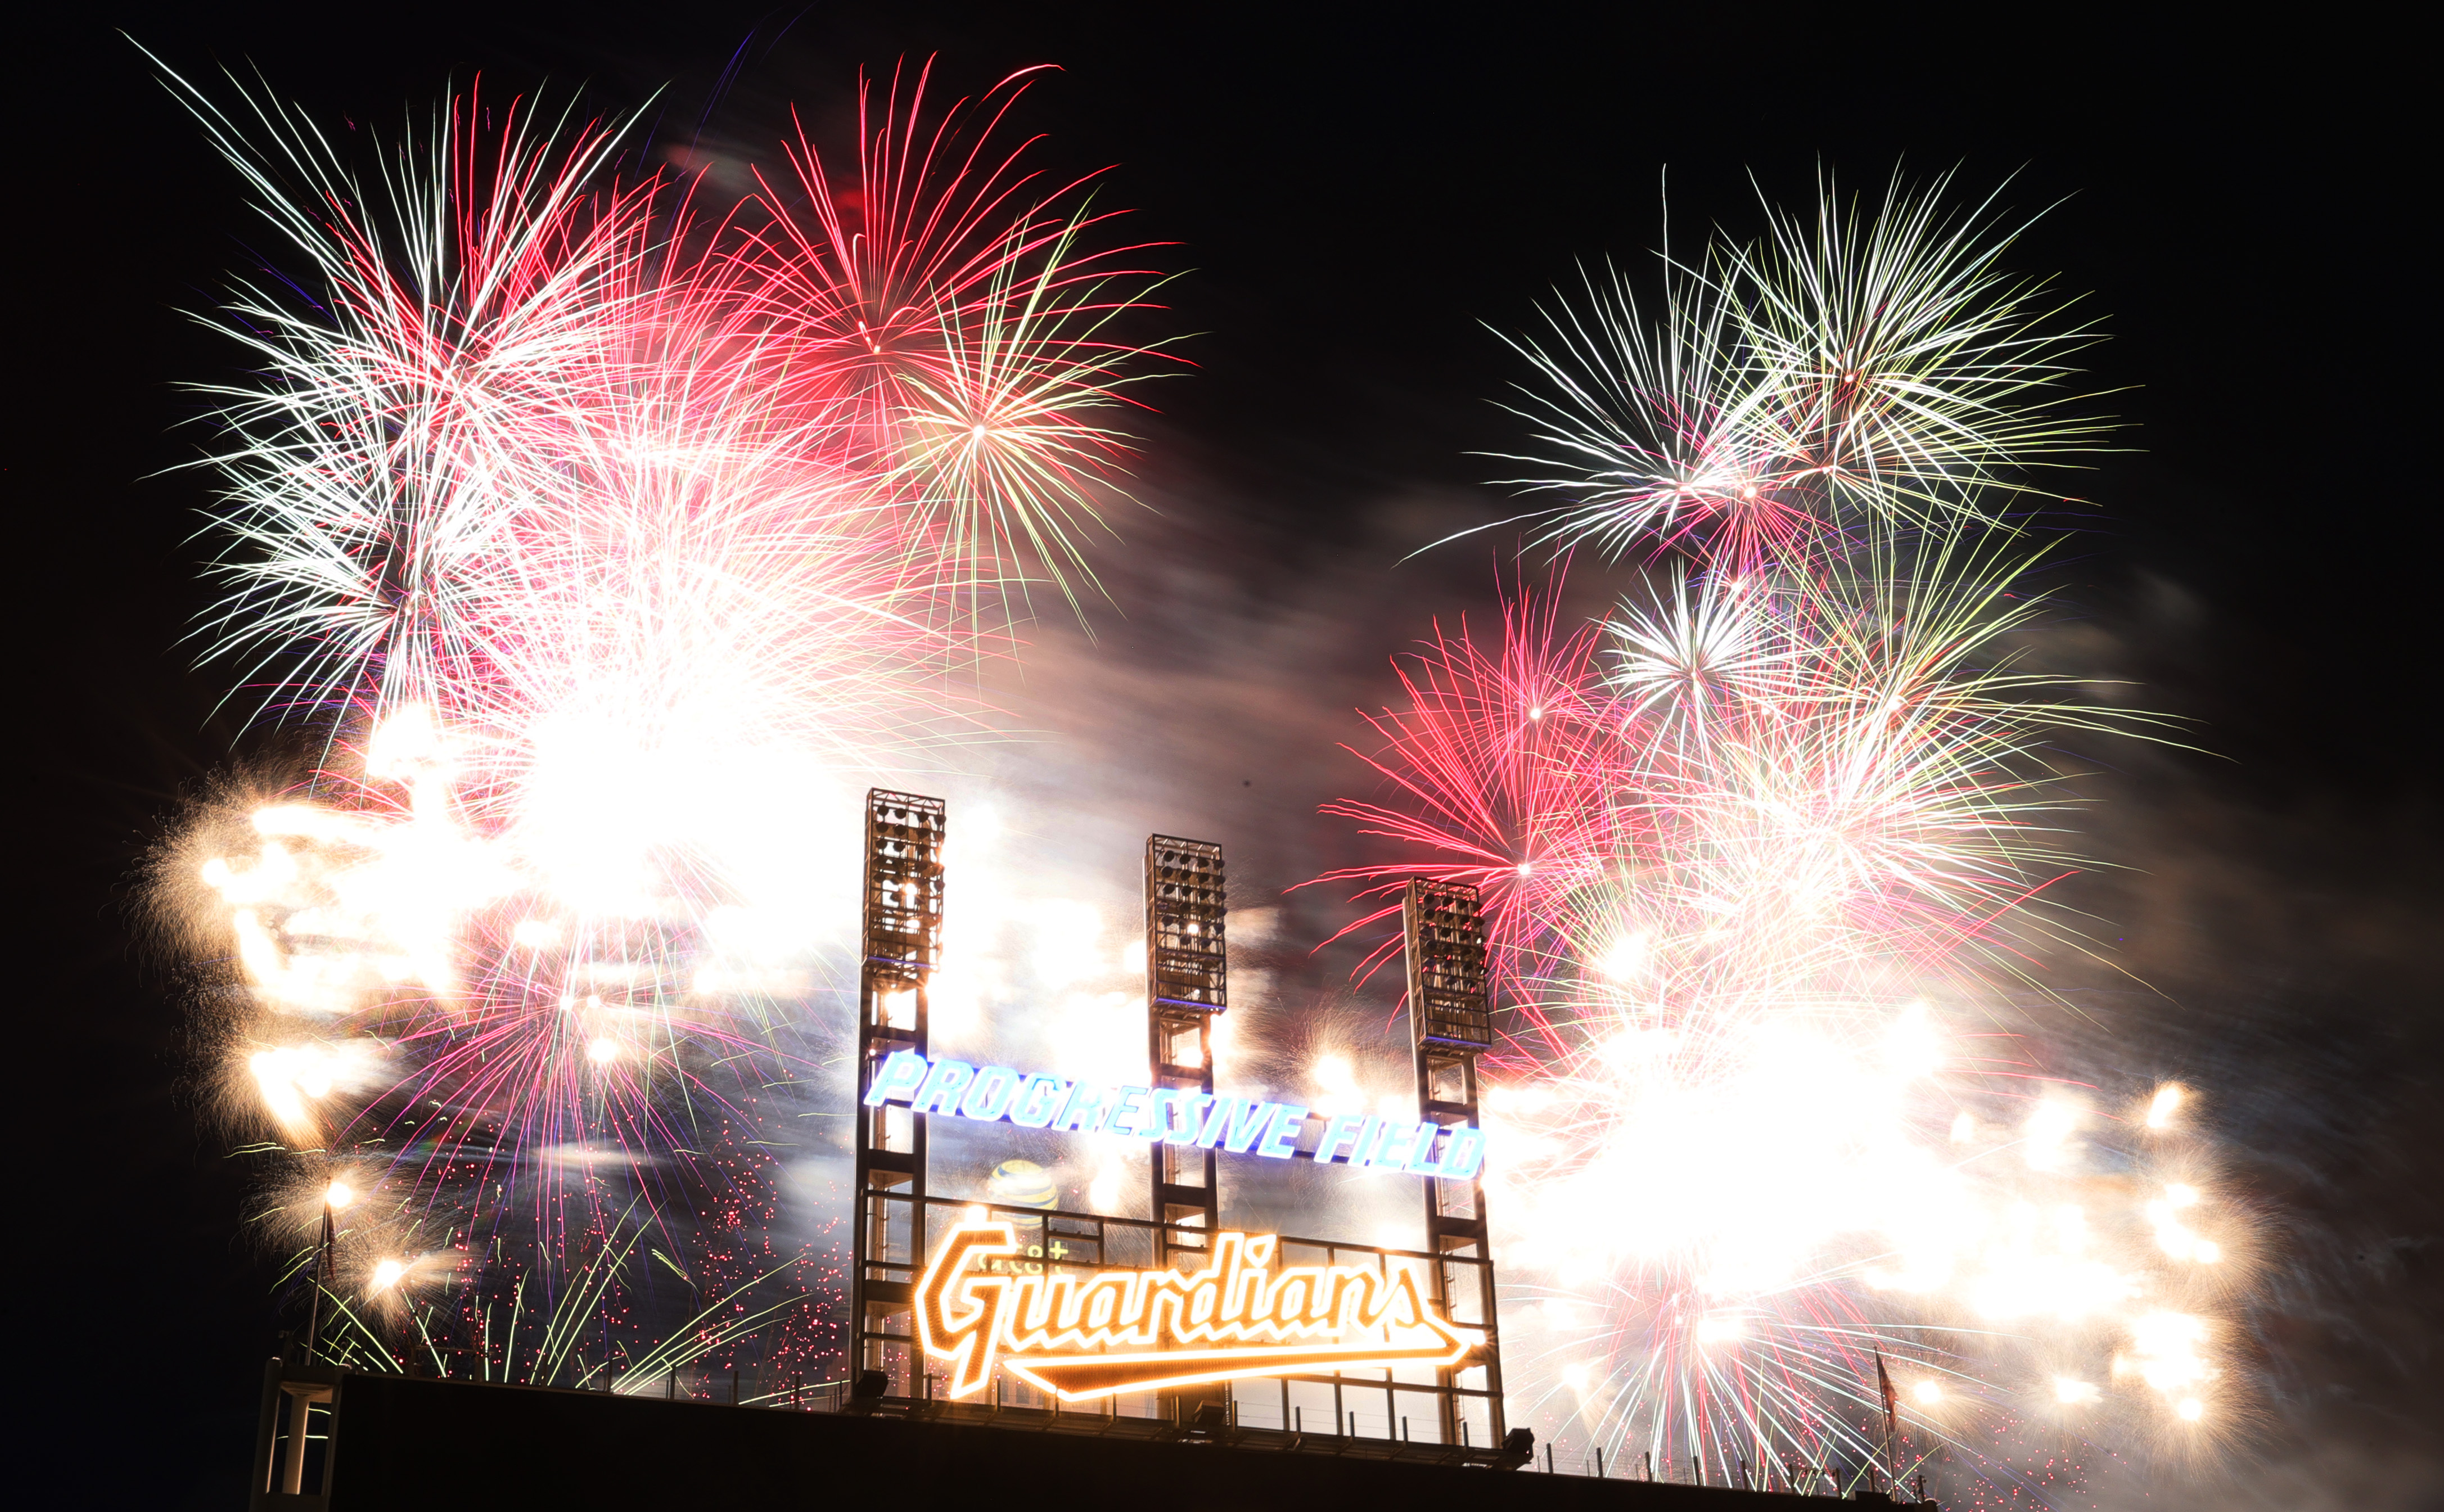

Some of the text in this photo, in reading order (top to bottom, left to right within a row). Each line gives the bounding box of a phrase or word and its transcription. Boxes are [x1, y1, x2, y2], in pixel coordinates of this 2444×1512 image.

[863, 1050, 1486, 1180] PROGRESSIVE FIELD
[914, 1219, 1483, 1400] Guardians
